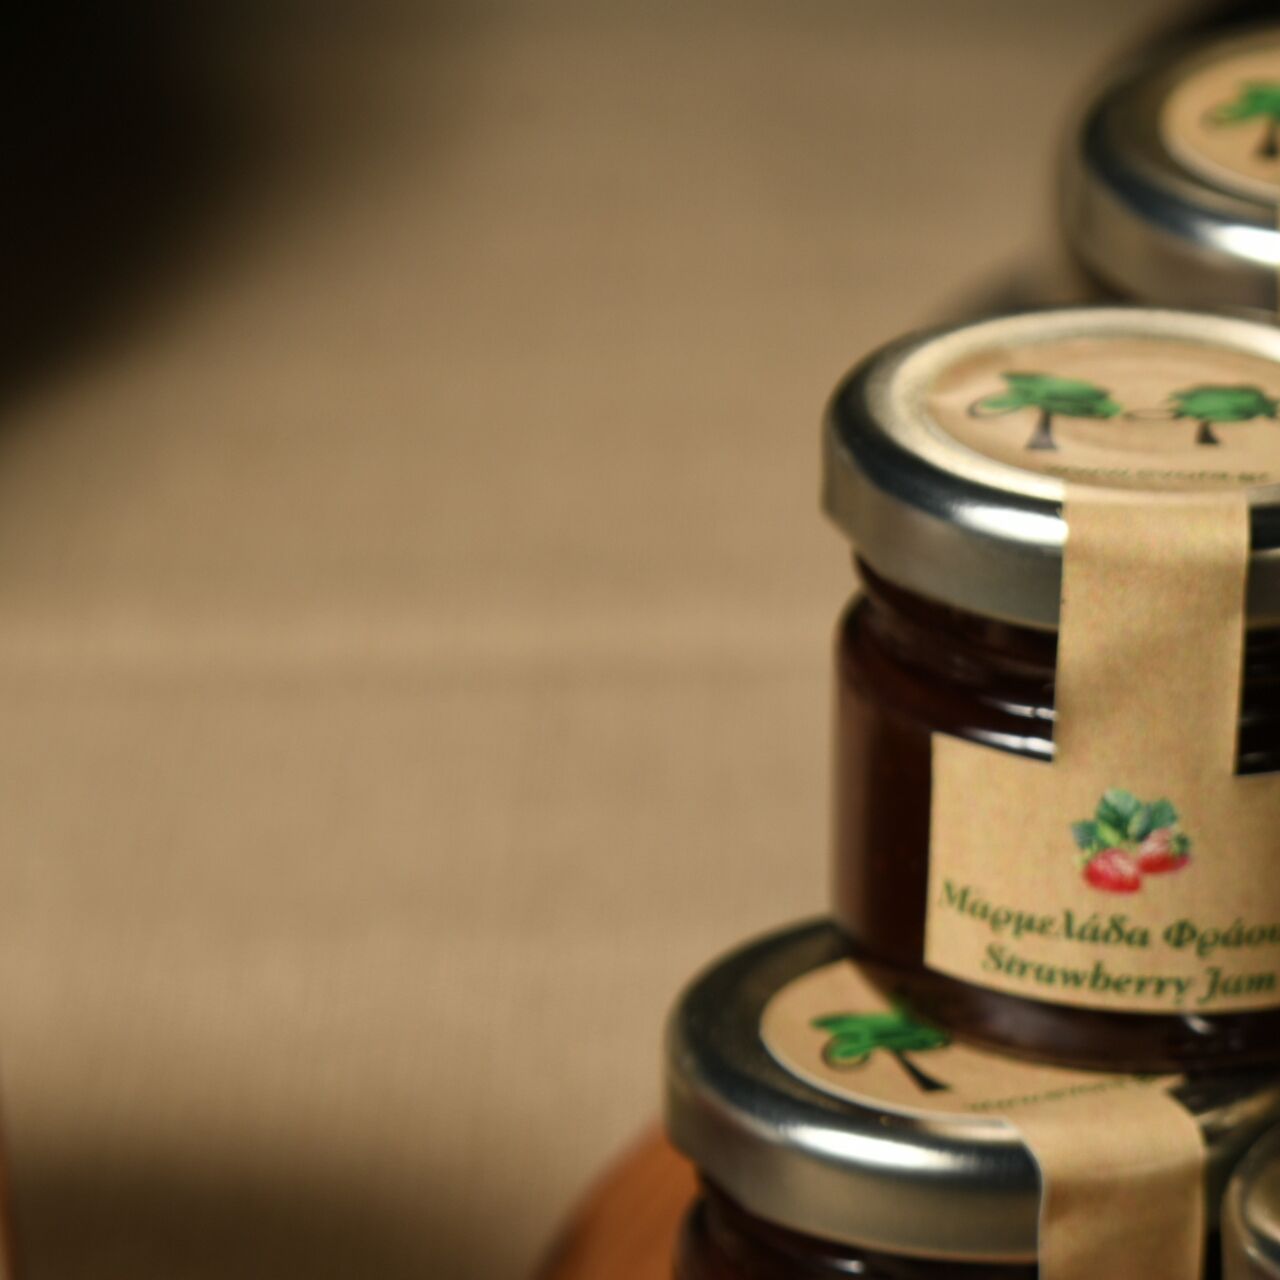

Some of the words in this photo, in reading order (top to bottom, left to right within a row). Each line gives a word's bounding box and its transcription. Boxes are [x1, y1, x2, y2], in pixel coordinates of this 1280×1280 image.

[939, 880, 1150, 948] Μαρμελάδα
[981, 943, 1190, 1002] Strawberry
[1203, 966, 1277, 1001] Jam
